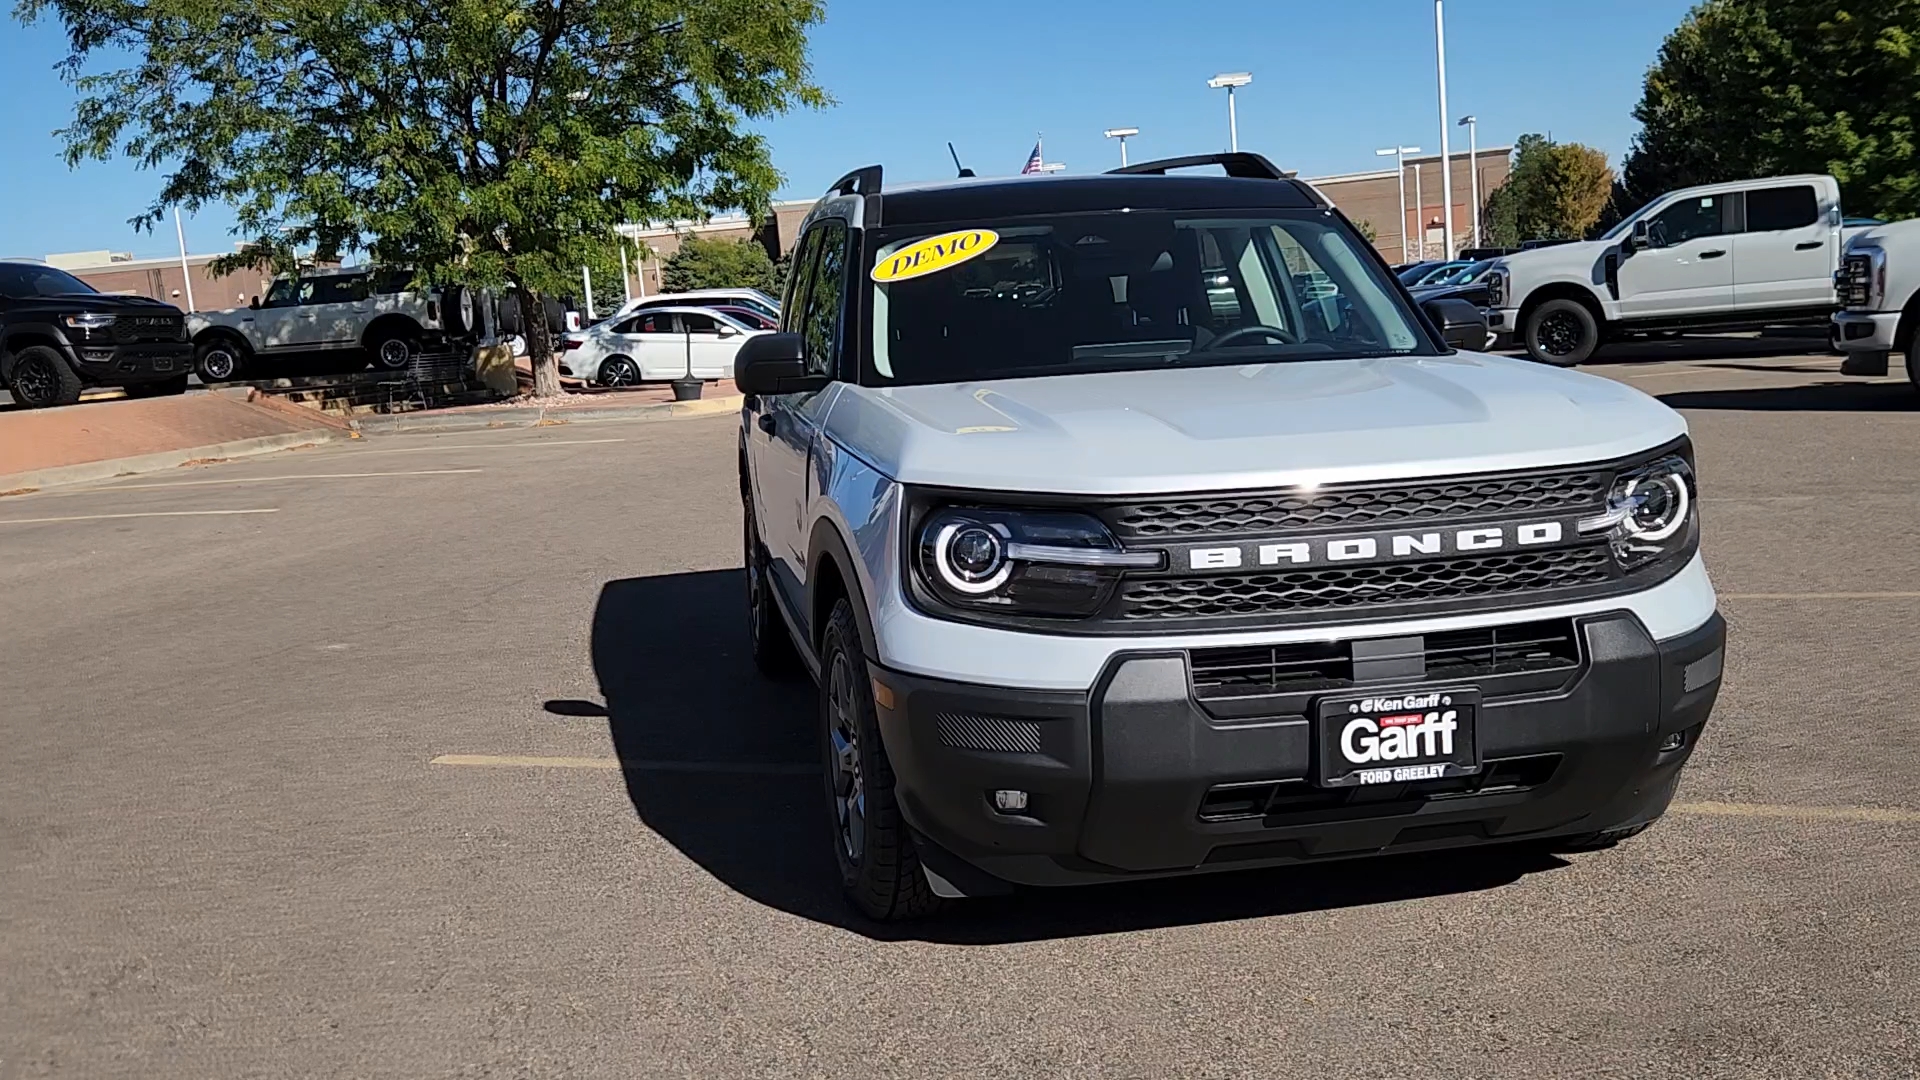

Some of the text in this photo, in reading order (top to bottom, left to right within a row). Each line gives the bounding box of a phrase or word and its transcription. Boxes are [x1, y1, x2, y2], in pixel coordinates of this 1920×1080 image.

[890, 233, 981, 277] DEMO
[1189, 522, 1562, 569] BRONCO
[1403, 693, 1440, 709] Garff
[1340, 710, 1457, 764] Garff
[1360, 765, 1446, 785] FORD GREELEY
